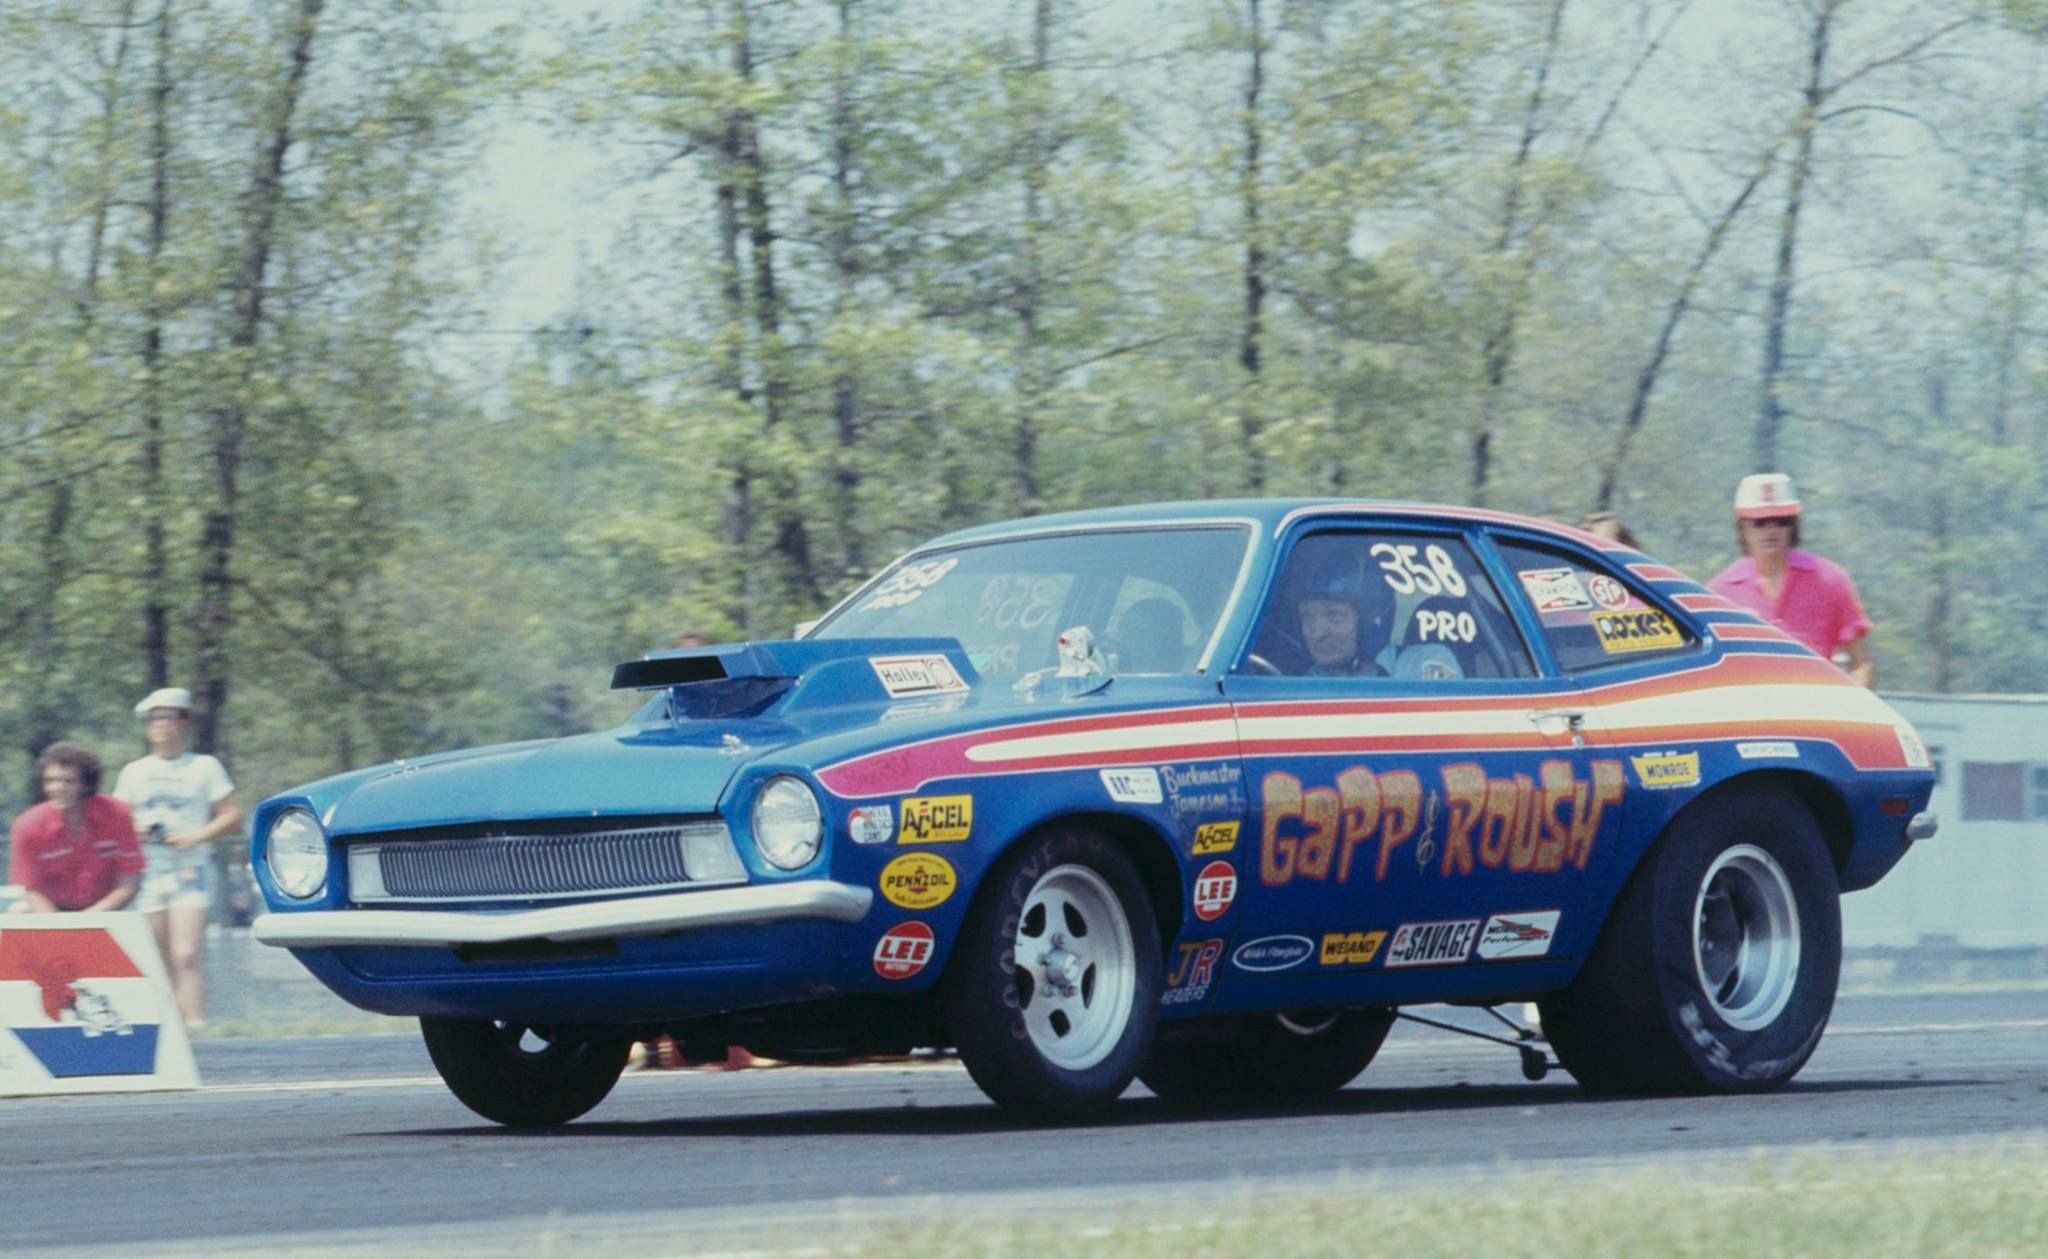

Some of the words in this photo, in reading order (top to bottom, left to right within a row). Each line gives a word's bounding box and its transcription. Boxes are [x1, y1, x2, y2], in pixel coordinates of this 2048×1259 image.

[1370, 543, 1467, 597] 358
[1594, 580, 1622, 604] STP
[1416, 610, 1477, 642] PRO
[881, 666, 931, 685] Holley
[1646, 762, 1690, 778] MONROE
[903, 801, 968, 838] ACCEL
[886, 873, 950, 889] PENNZOIL
[1199, 879, 1234, 901] LEE
[880, 938, 929, 961] LEE
[1326, 940, 1377, 956] WEIAND
[1404, 923, 1476, 961] SAVAGE
